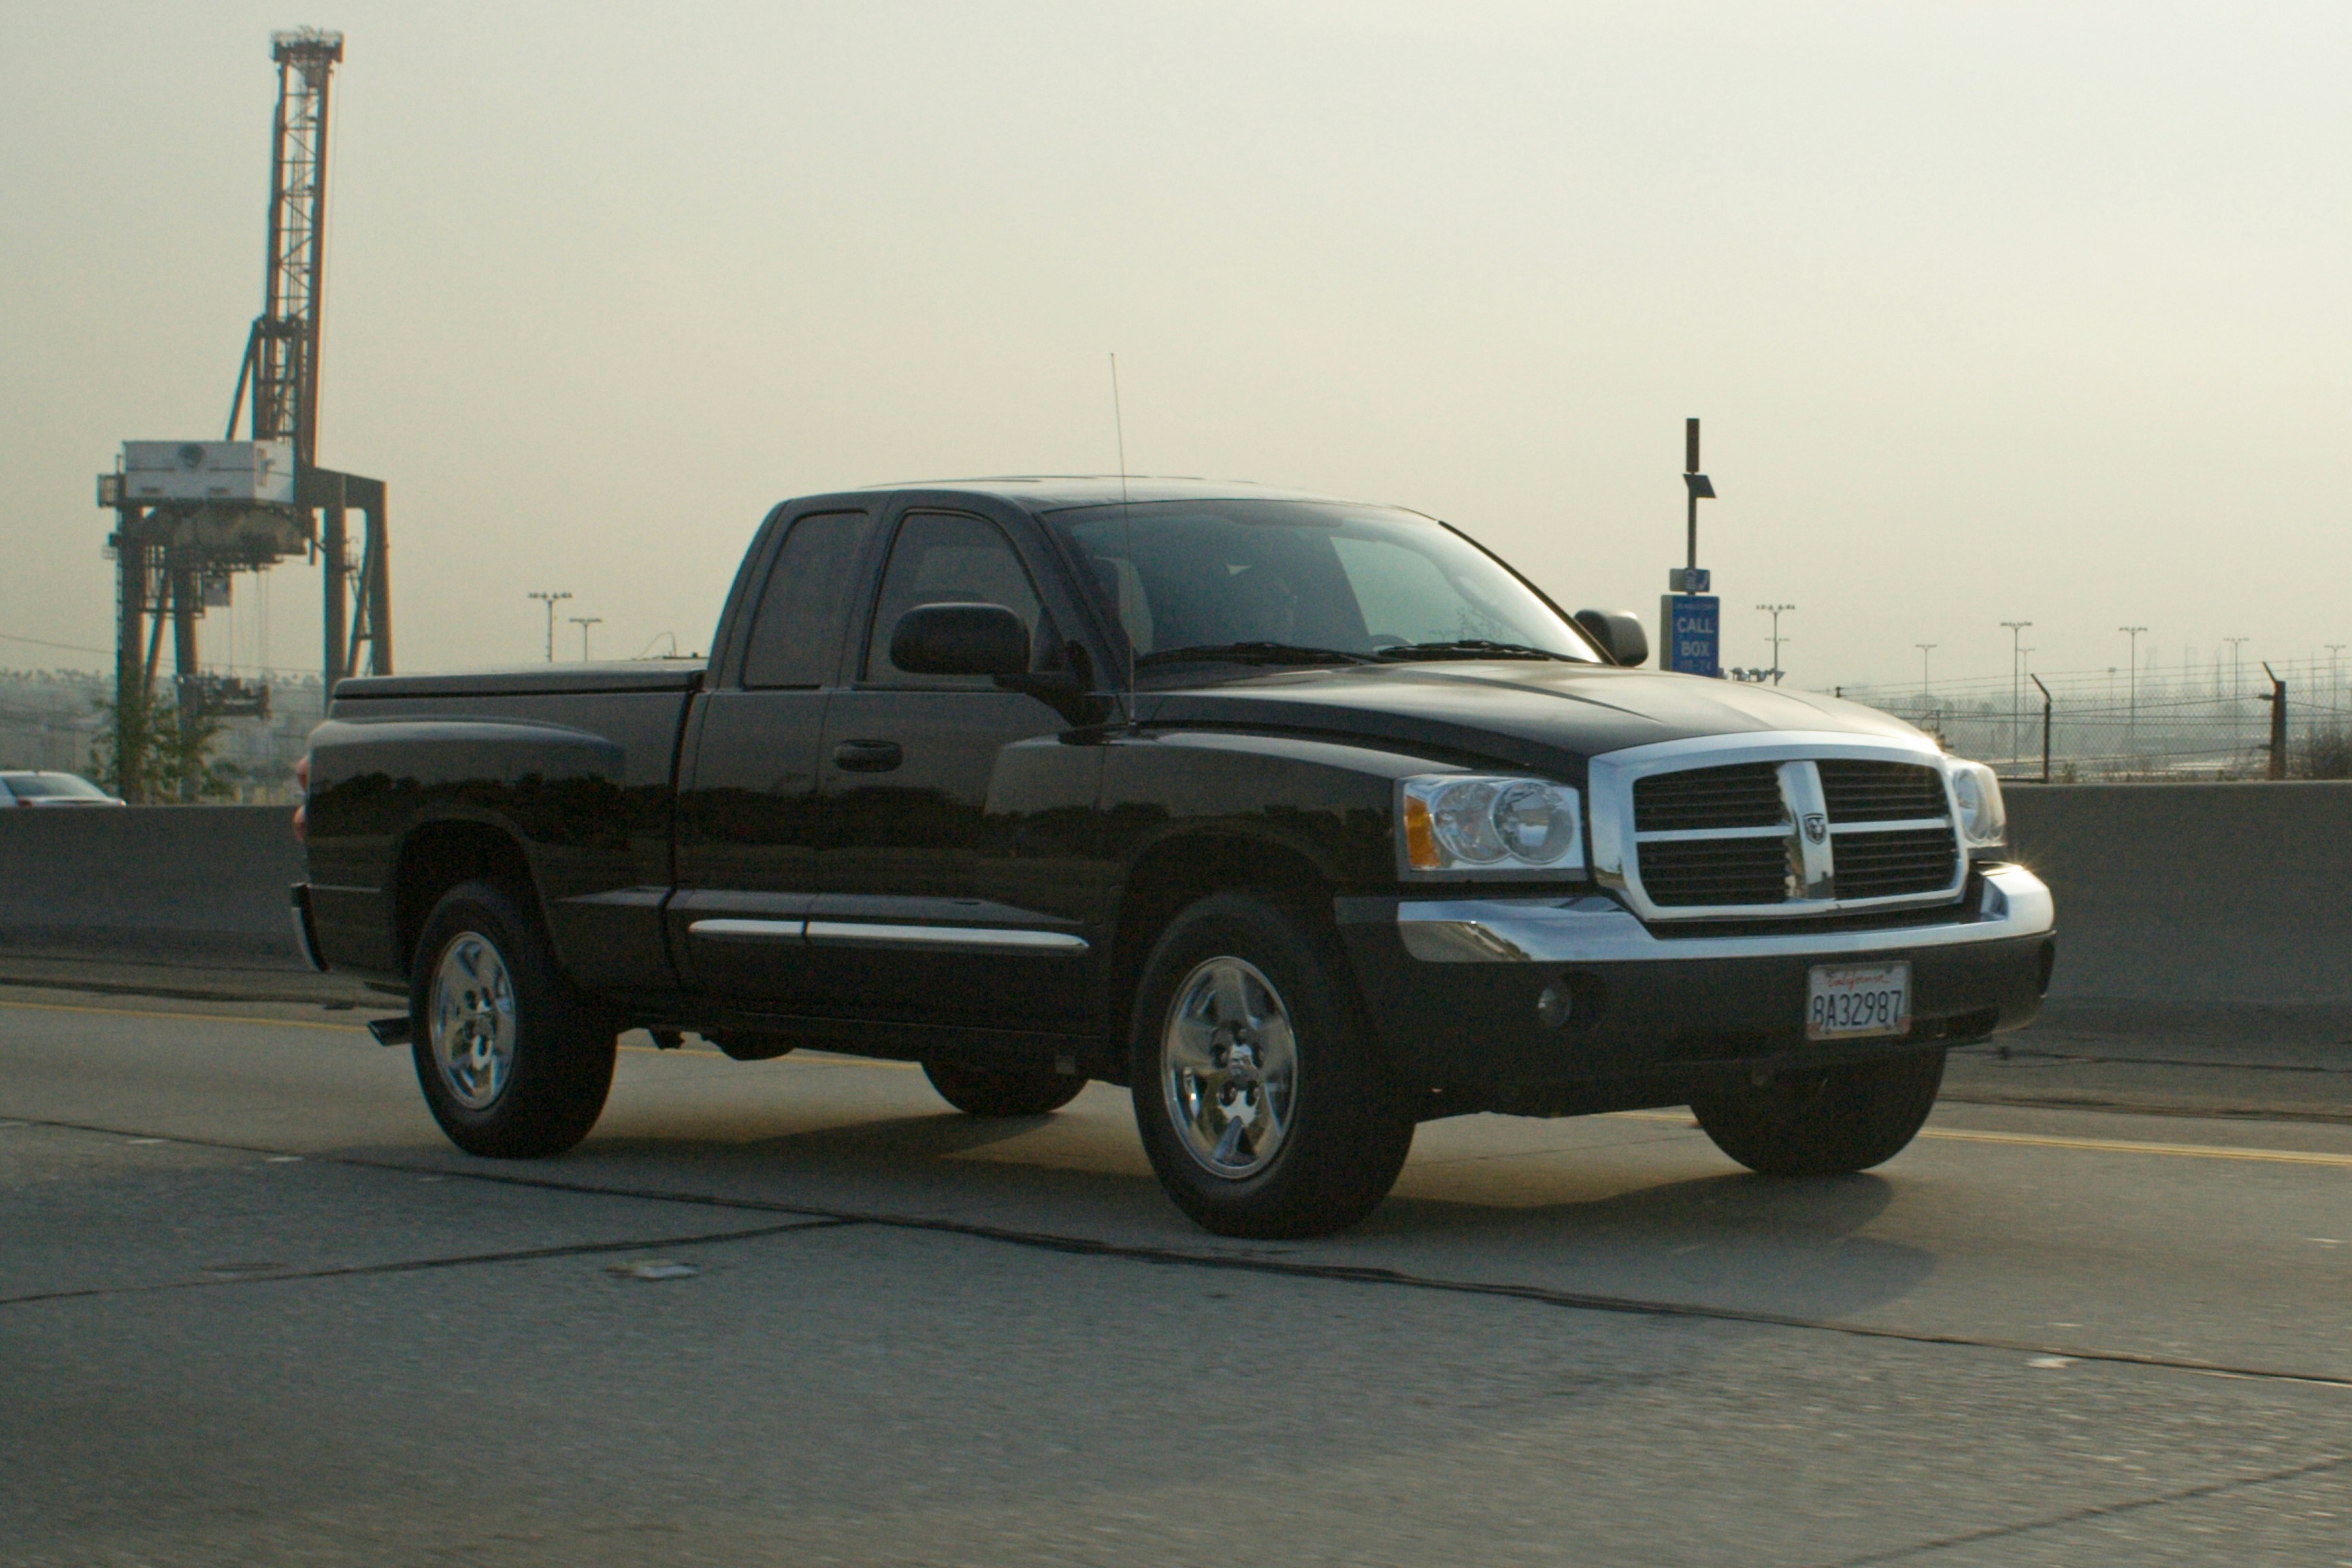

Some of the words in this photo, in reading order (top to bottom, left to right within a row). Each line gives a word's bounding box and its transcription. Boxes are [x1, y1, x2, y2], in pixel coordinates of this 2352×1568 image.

[1677, 617, 1714, 634] CALL
[1681, 641, 1710, 657] BOX
[1813, 990, 1902, 1026] 8A32987
